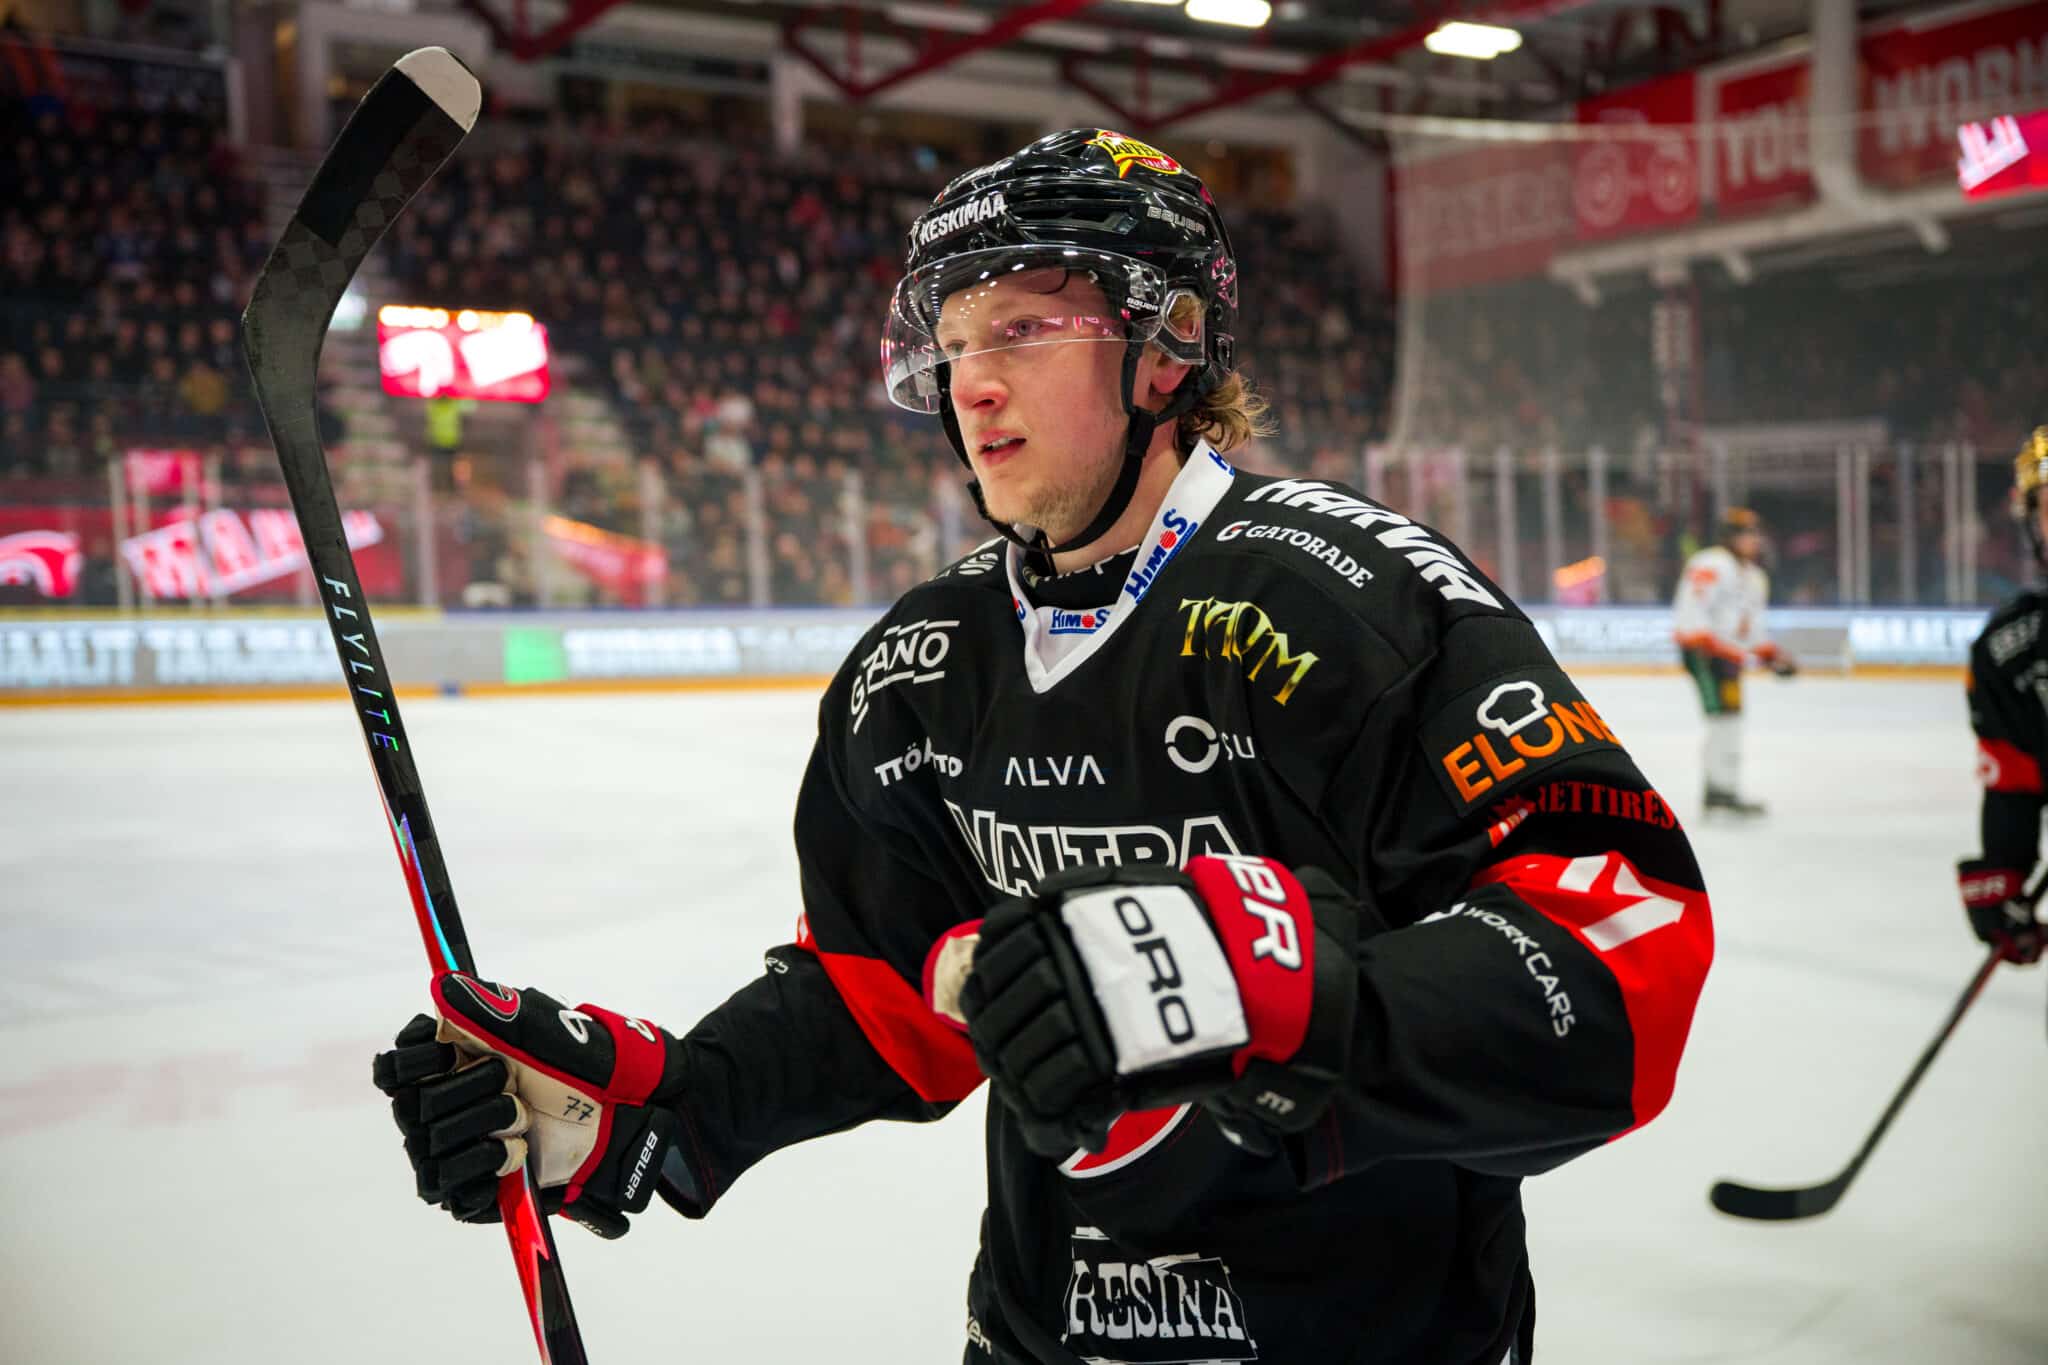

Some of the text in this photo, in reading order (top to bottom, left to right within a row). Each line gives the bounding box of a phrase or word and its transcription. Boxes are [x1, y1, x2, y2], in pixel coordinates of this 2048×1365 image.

[1246, 525, 1374, 589] GATORADE
[322, 573, 400, 752] FLYLITE
[1004, 754, 1106, 788] ALVA
[1112, 895, 1196, 1045] ORO
[566, 1094, 596, 1122] 77
